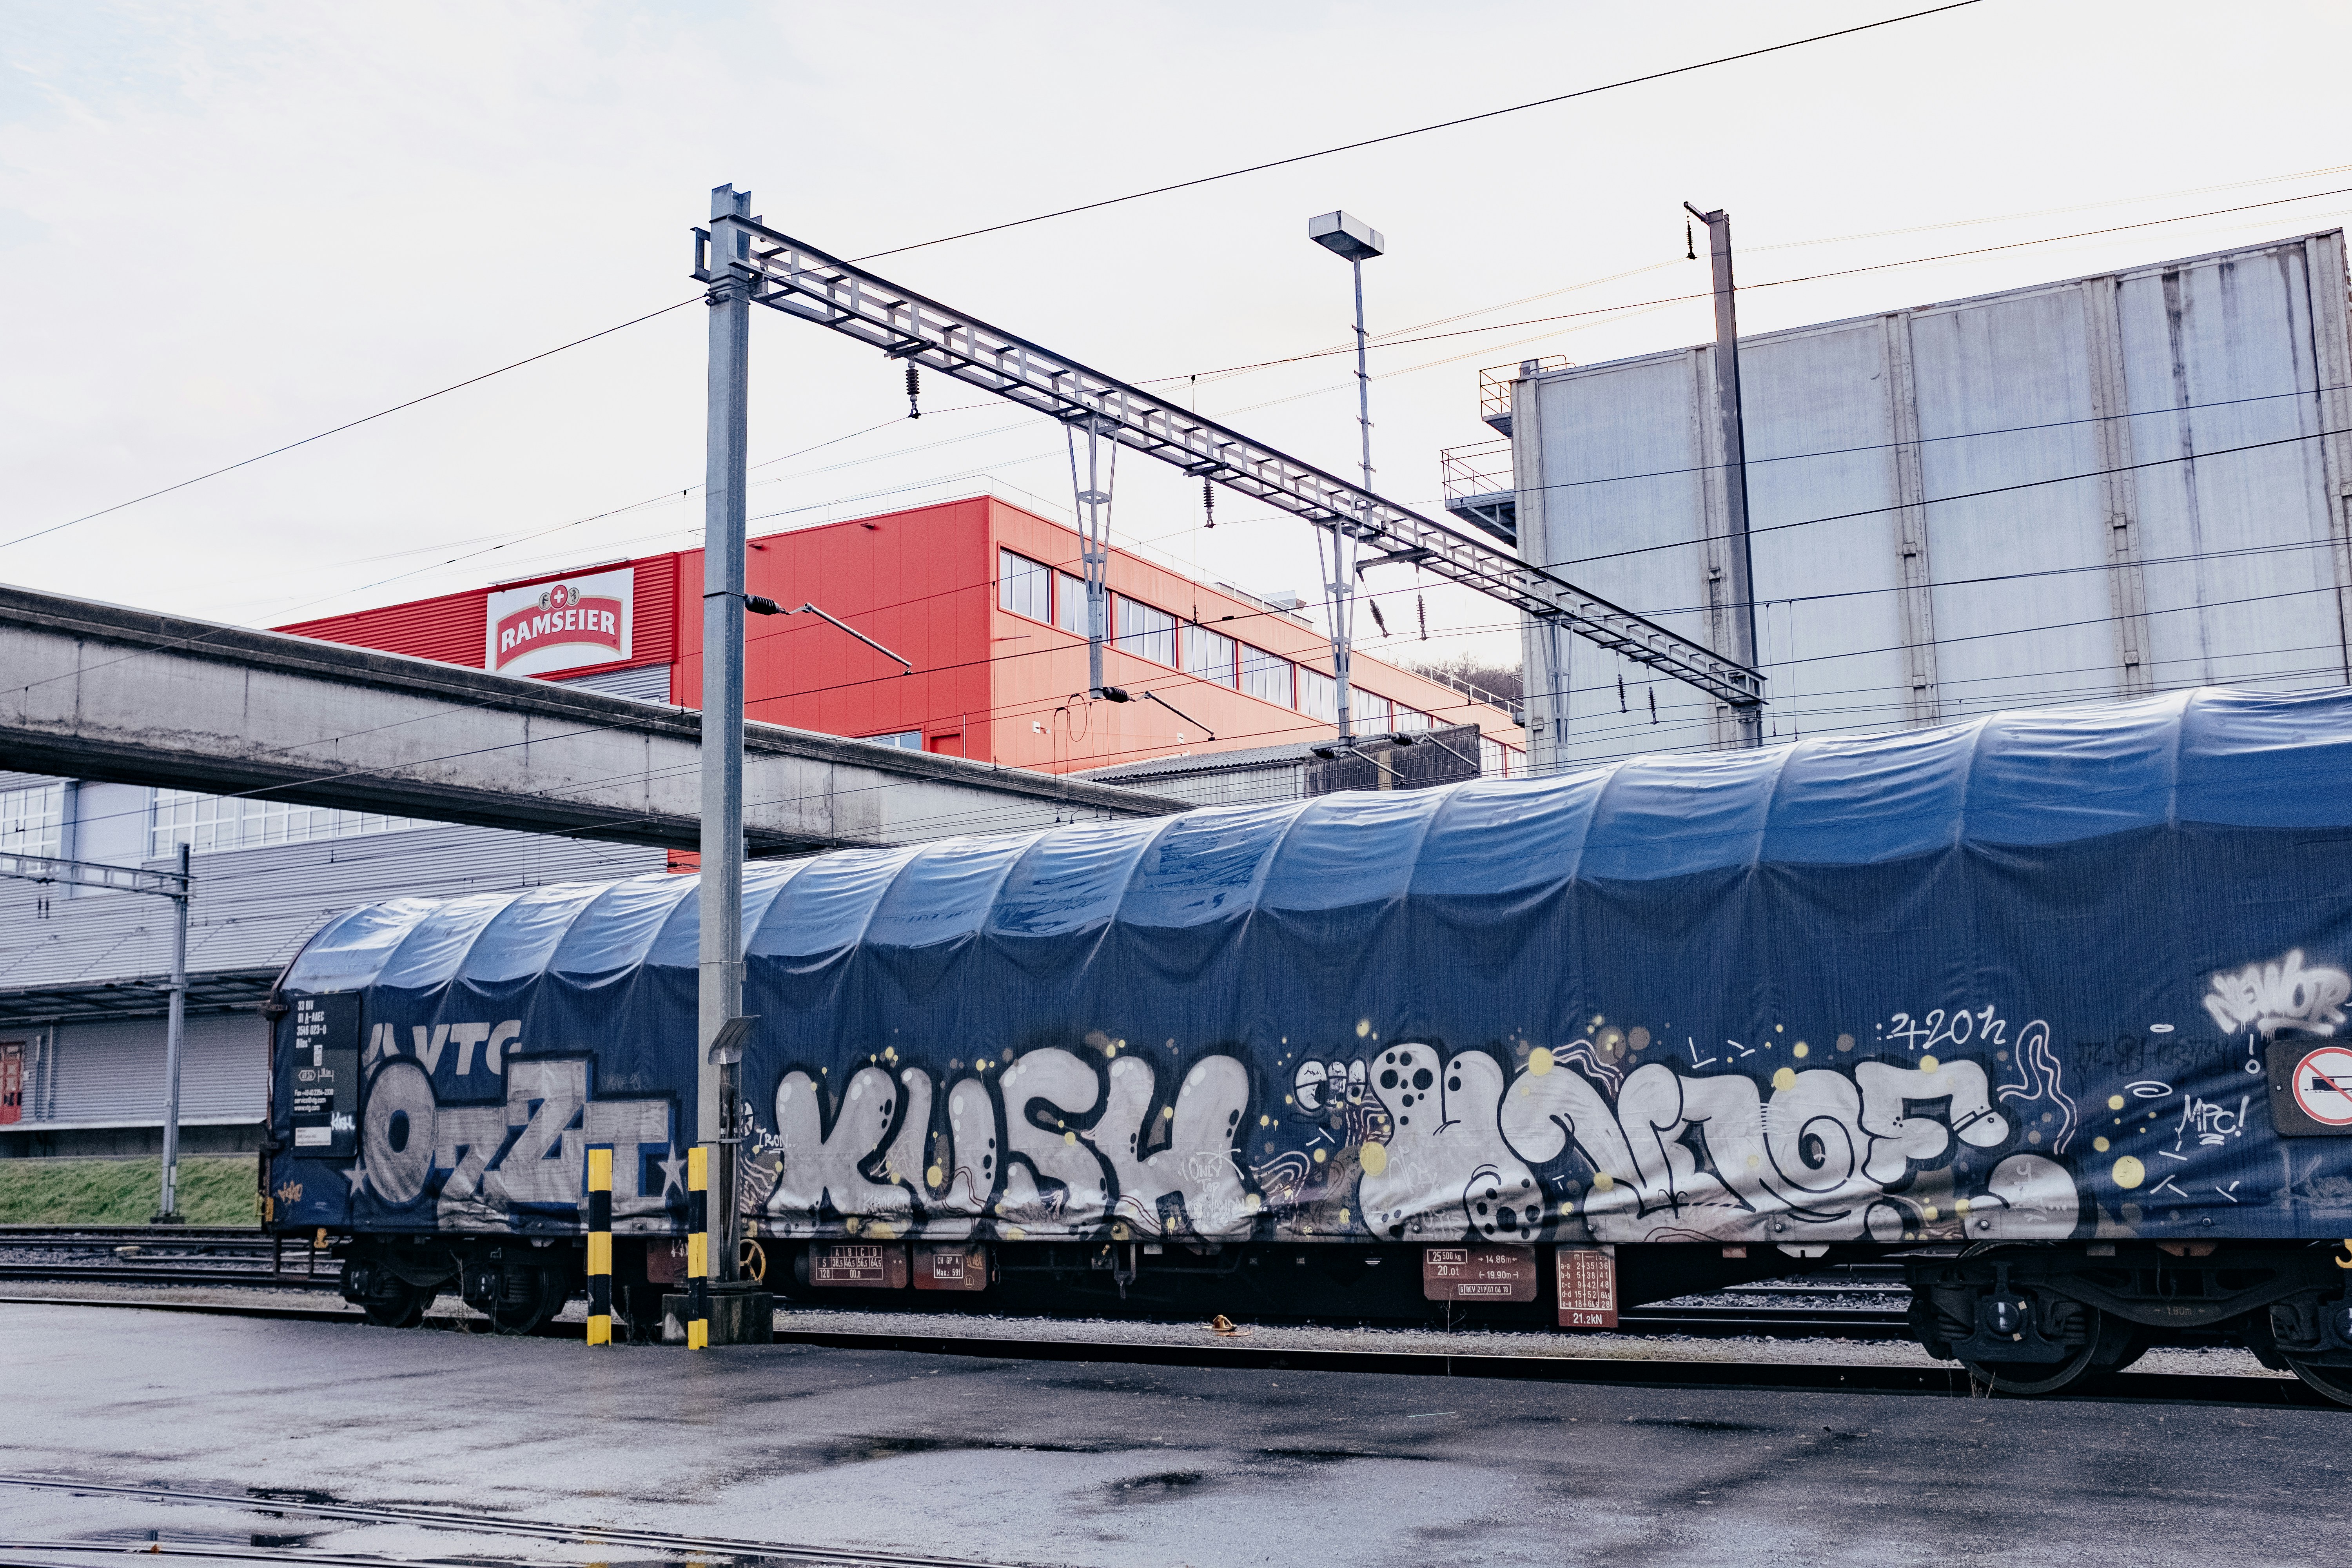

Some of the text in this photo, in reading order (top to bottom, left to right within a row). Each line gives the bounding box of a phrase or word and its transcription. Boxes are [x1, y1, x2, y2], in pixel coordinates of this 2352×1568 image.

[501, 609, 615, 654] RAMSEIER
[835, 1248, 877, 1256] A B C D
[1433, 1252, 1441, 1261] 25
[823, 1258, 826, 1267] S
[1486, 1255, 1511, 1263] 14.86m
[820, 1269, 829, 1278] 120
[1573, 1312, 1602, 1324] 21.2kN
